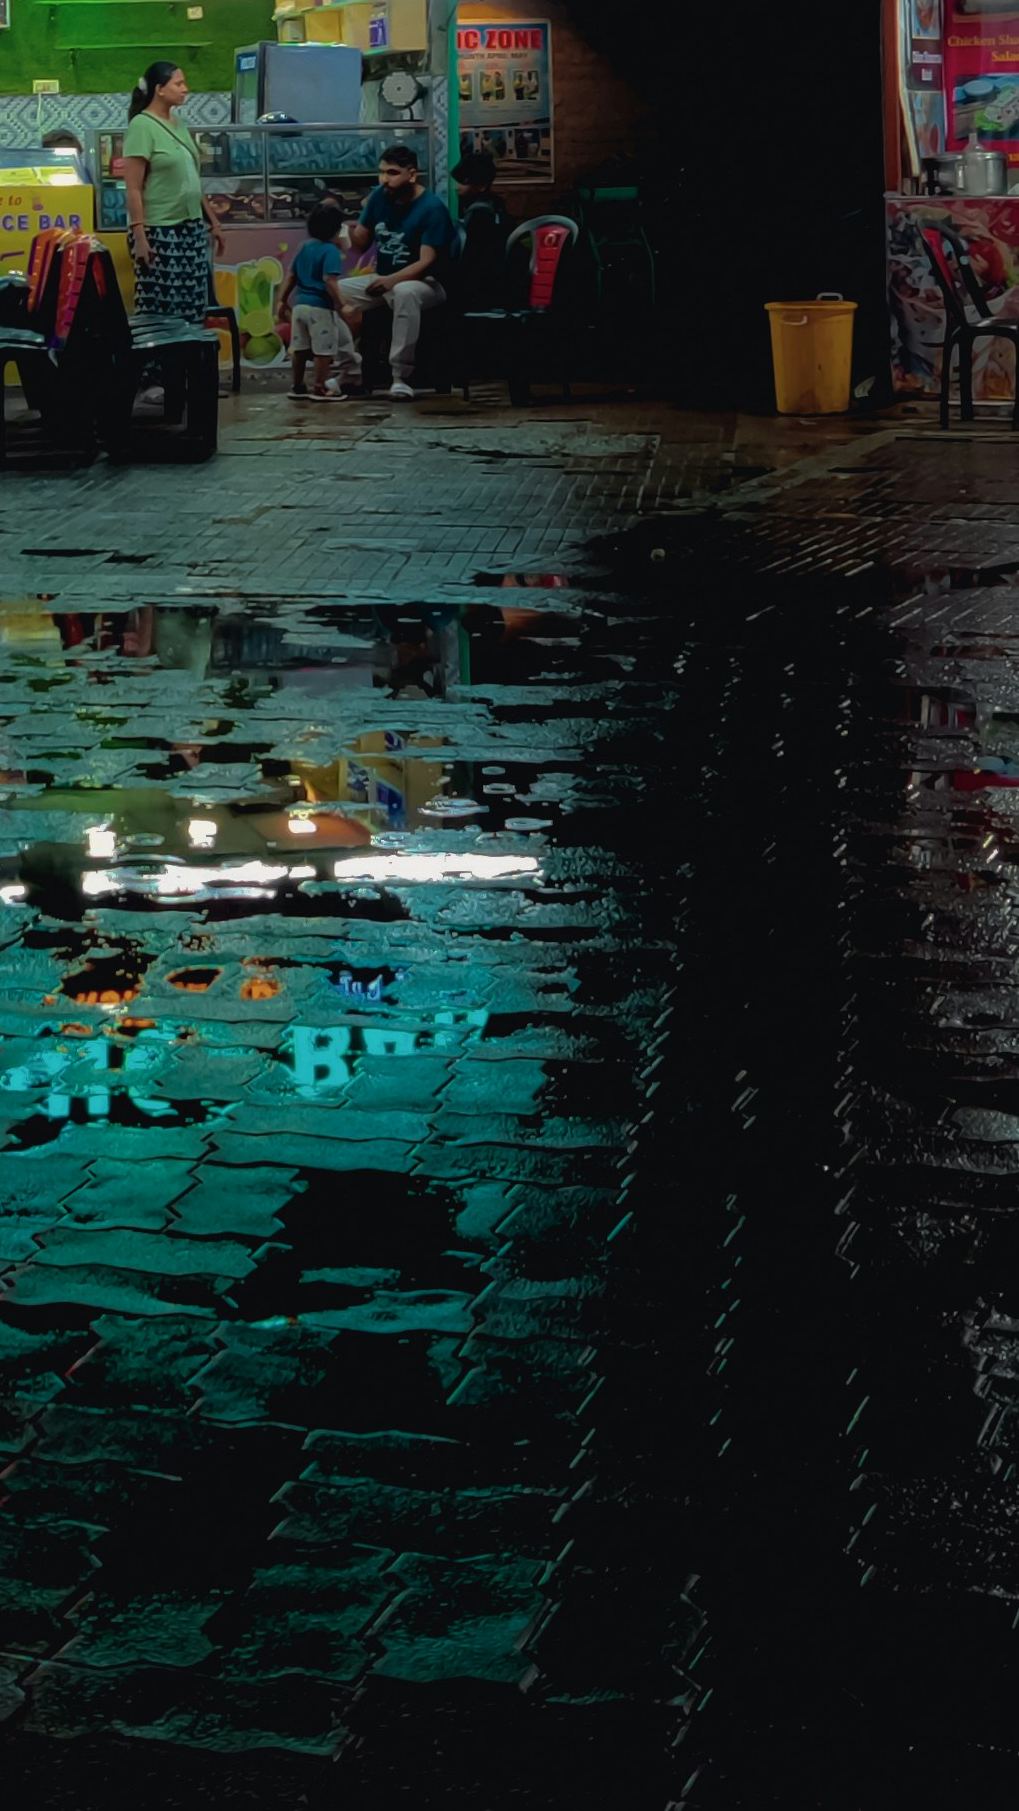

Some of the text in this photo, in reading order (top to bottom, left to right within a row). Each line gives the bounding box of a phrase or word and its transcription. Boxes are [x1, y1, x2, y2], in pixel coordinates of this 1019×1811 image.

[485, 29, 542, 50] ZONE
[8, 196, 22, 206] to
[39, 214, 81, 230] BAR
